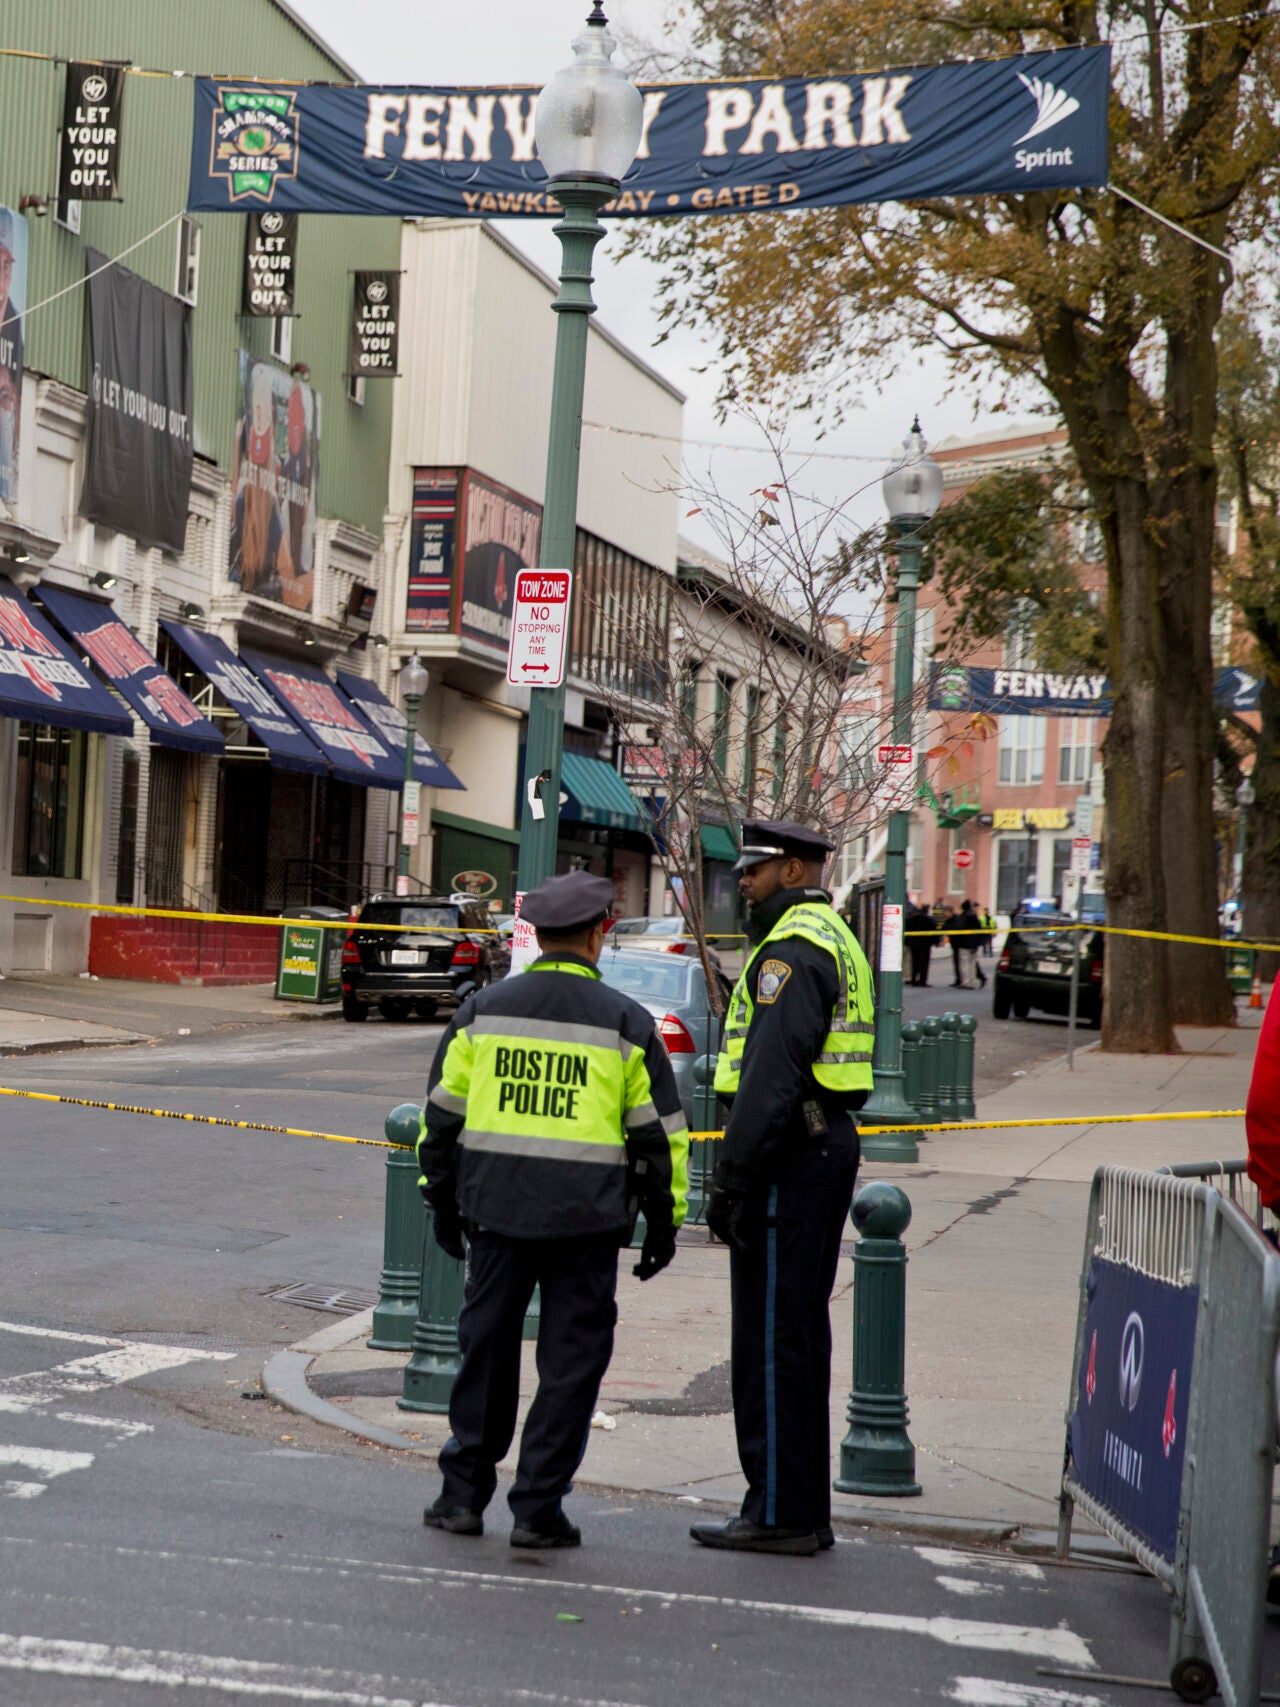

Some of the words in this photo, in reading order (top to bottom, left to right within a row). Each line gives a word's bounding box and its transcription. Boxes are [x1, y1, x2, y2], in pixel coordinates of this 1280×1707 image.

[75, 106, 110, 123] LET
[701, 74, 914, 157] PARK
[67, 127, 117, 145] YOUR
[72, 148, 109, 165] YOU
[229, 156, 279, 172] SERIES
[1014, 146, 1074, 173] Sprint
[70, 169, 111, 186] OUT.
[691, 184, 771, 210] GATE
[778, 183, 801, 202] D
[255, 236, 286, 252] LET
[248, 254, 292, 270] YOUR
[253, 272, 286, 288] YOU
[251, 289, 288, 306] OUT.
[362, 304, 391, 319] LET
[356, 321, 396, 335] YOUR
[361, 337, 391, 351] YOU
[359, 353, 393, 367] OUT.
[103, 377, 121, 410] LET
[122, 386, 148, 422] YOUR
[148, 399, 167, 432] YOU
[169, 409, 190, 442] OUT.
[423, 542, 443, 559] year
[520, 579, 541, 598] TOW
[541, 580, 567, 599] ZONE
[530, 606, 551, 621] NO
[517, 622, 562, 634] STOPPING
[530, 634, 546, 646] ANY
[528, 645, 547, 656] TIME
[993, 671, 1107, 699] FENWAY
[494, 1046, 589, 1088] BOSTON
[498, 1081, 581, 1121] POLICE
